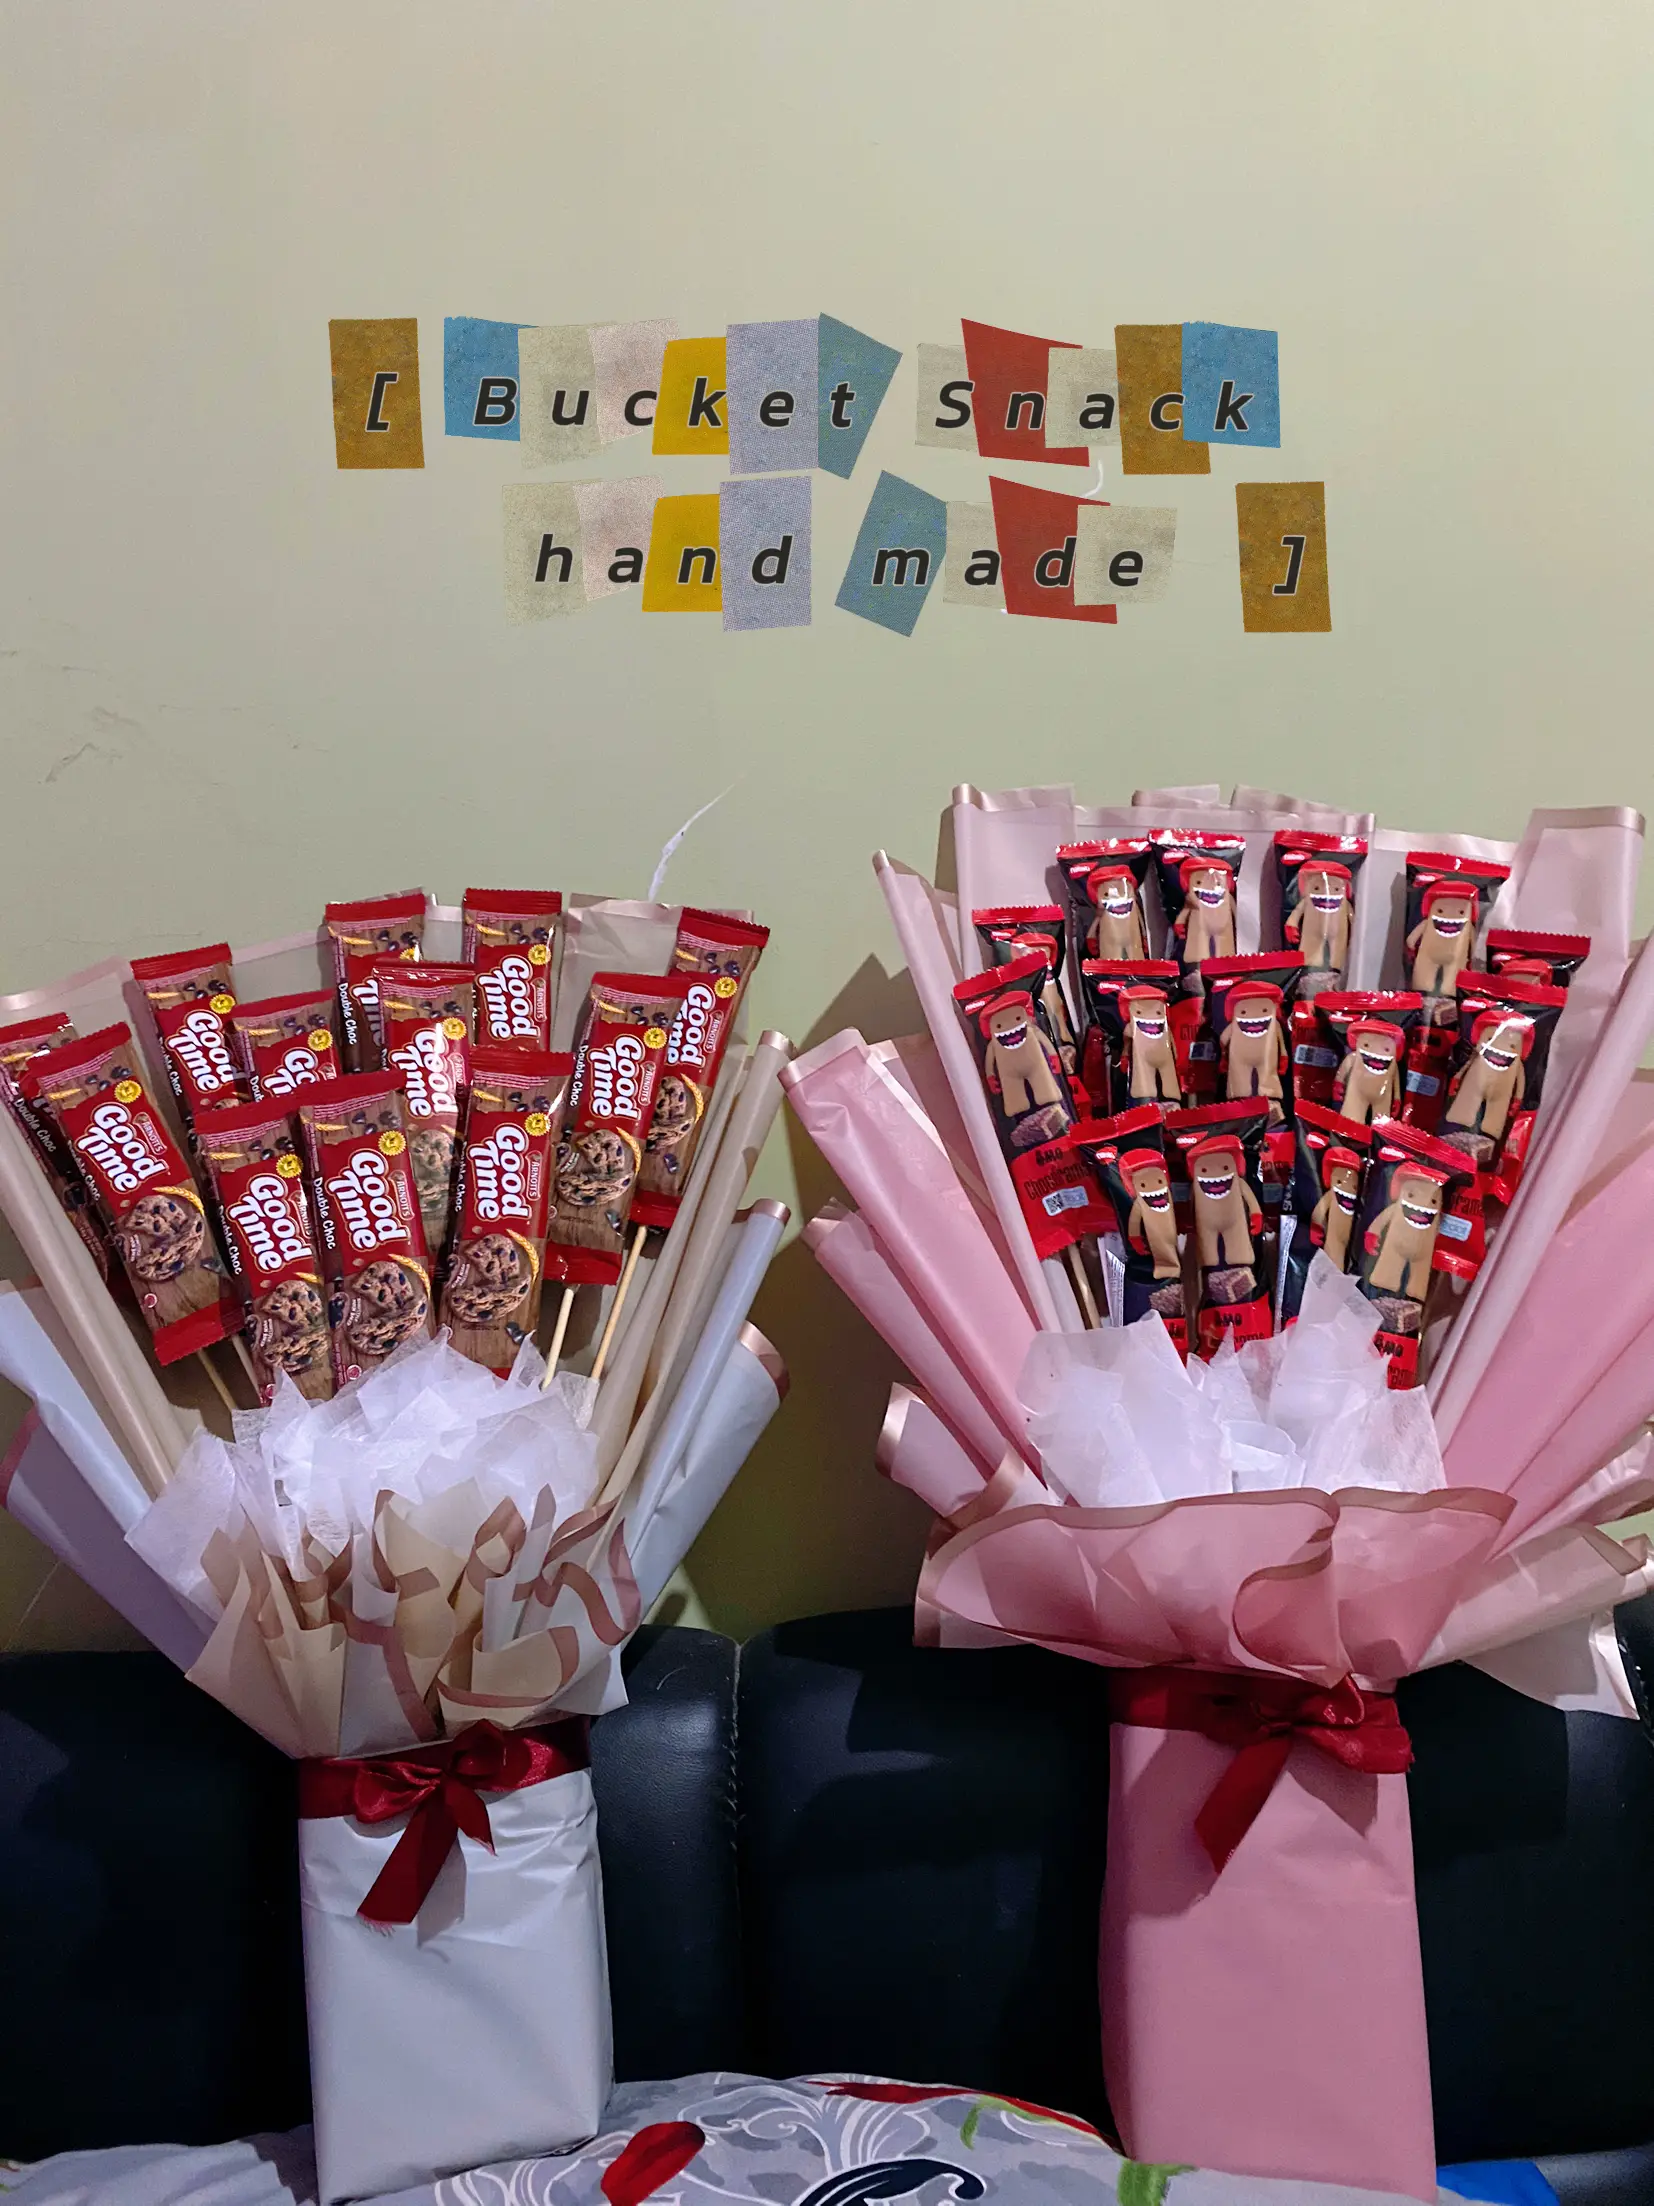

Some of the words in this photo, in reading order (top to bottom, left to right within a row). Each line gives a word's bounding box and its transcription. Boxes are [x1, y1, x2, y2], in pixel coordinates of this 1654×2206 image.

[338, 982, 353, 1018] Double
[345, 1019, 358, 1045] Choc
[478, 969, 511, 1039] Time
[502, 957, 538, 1036] Good
[680, 985, 713, 1066] Good
[167, 1028, 220, 1091] Time
[186, 1011, 246, 1084] Good
[391, 1045, 432, 1117] Time
[415, 1030, 459, 1113] Good
[574, 1044, 589, 1080] Double
[589, 1046, 617, 1117] Time
[613, 1036, 642, 1119] Good
[13, 1097, 40, 1132] Double
[36, 1129, 57, 1153] Choc
[569, 1081, 584, 1107] Choc
[77, 1126, 138, 1192] Time
[93, 1105, 166, 1180] Good
[469, 1139, 500, 1219] Time
[495, 1126, 529, 1217] Good
[85, 1174, 101, 1201] Choc
[249, 1176, 313, 1262] Good
[313, 1176, 329, 1219] Double
[322, 1219, 337, 1250] Choc
[328, 1169, 377, 1249] Time
[351, 1151, 408, 1242] Good
[228, 1245, 243, 1275] Choc
[229, 1194, 283, 1271] Time
